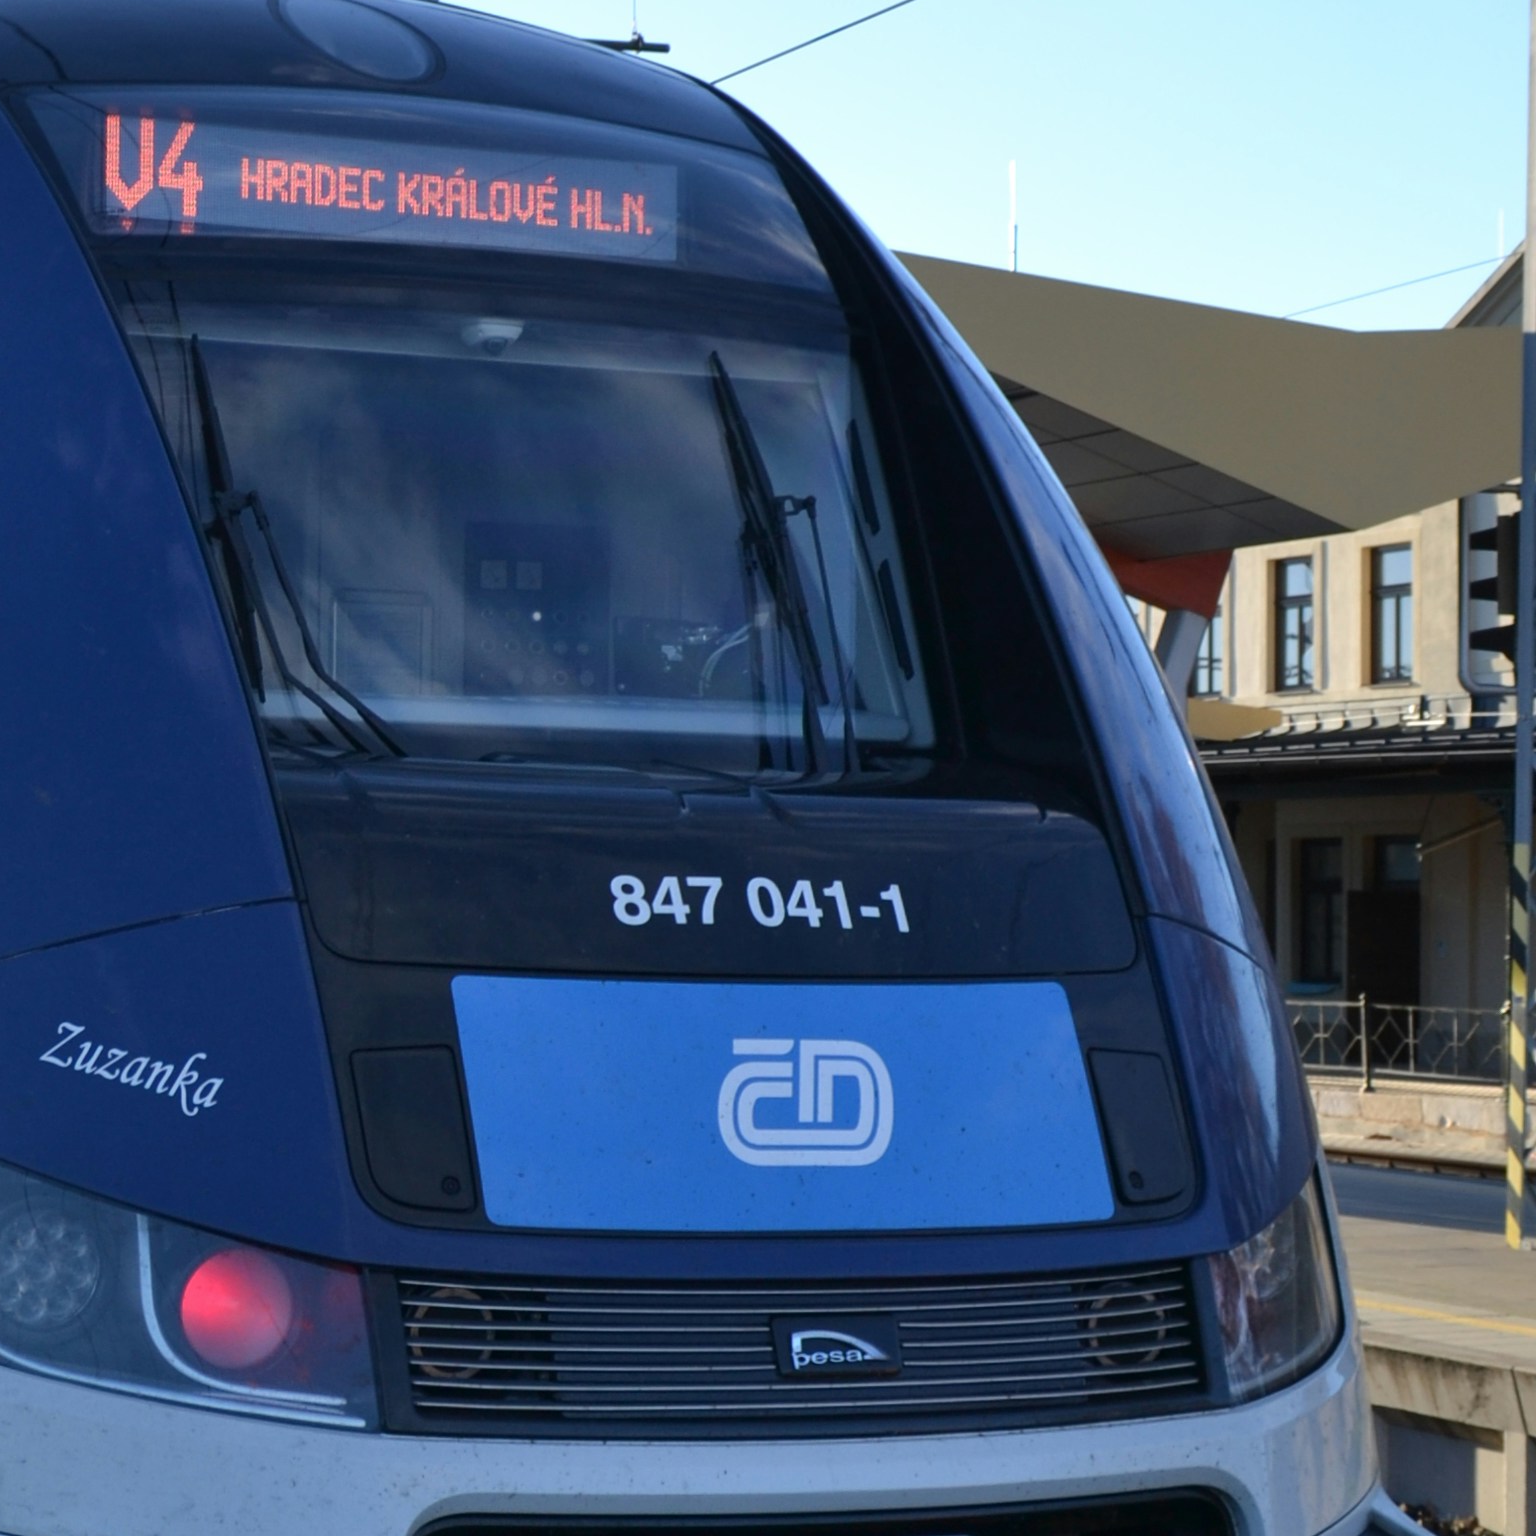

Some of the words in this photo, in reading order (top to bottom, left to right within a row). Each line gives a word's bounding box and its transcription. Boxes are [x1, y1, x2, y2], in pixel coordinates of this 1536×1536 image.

[241, 157, 385, 211] HRADEC
[397, 167, 559, 227] KRÁLOVÉ
[570, 188, 654, 235] HL.N.
[610, 874, 723, 926] 847
[746, 877, 910, 933] 041-1
[39, 1021, 225, 1117] Zuzanka
